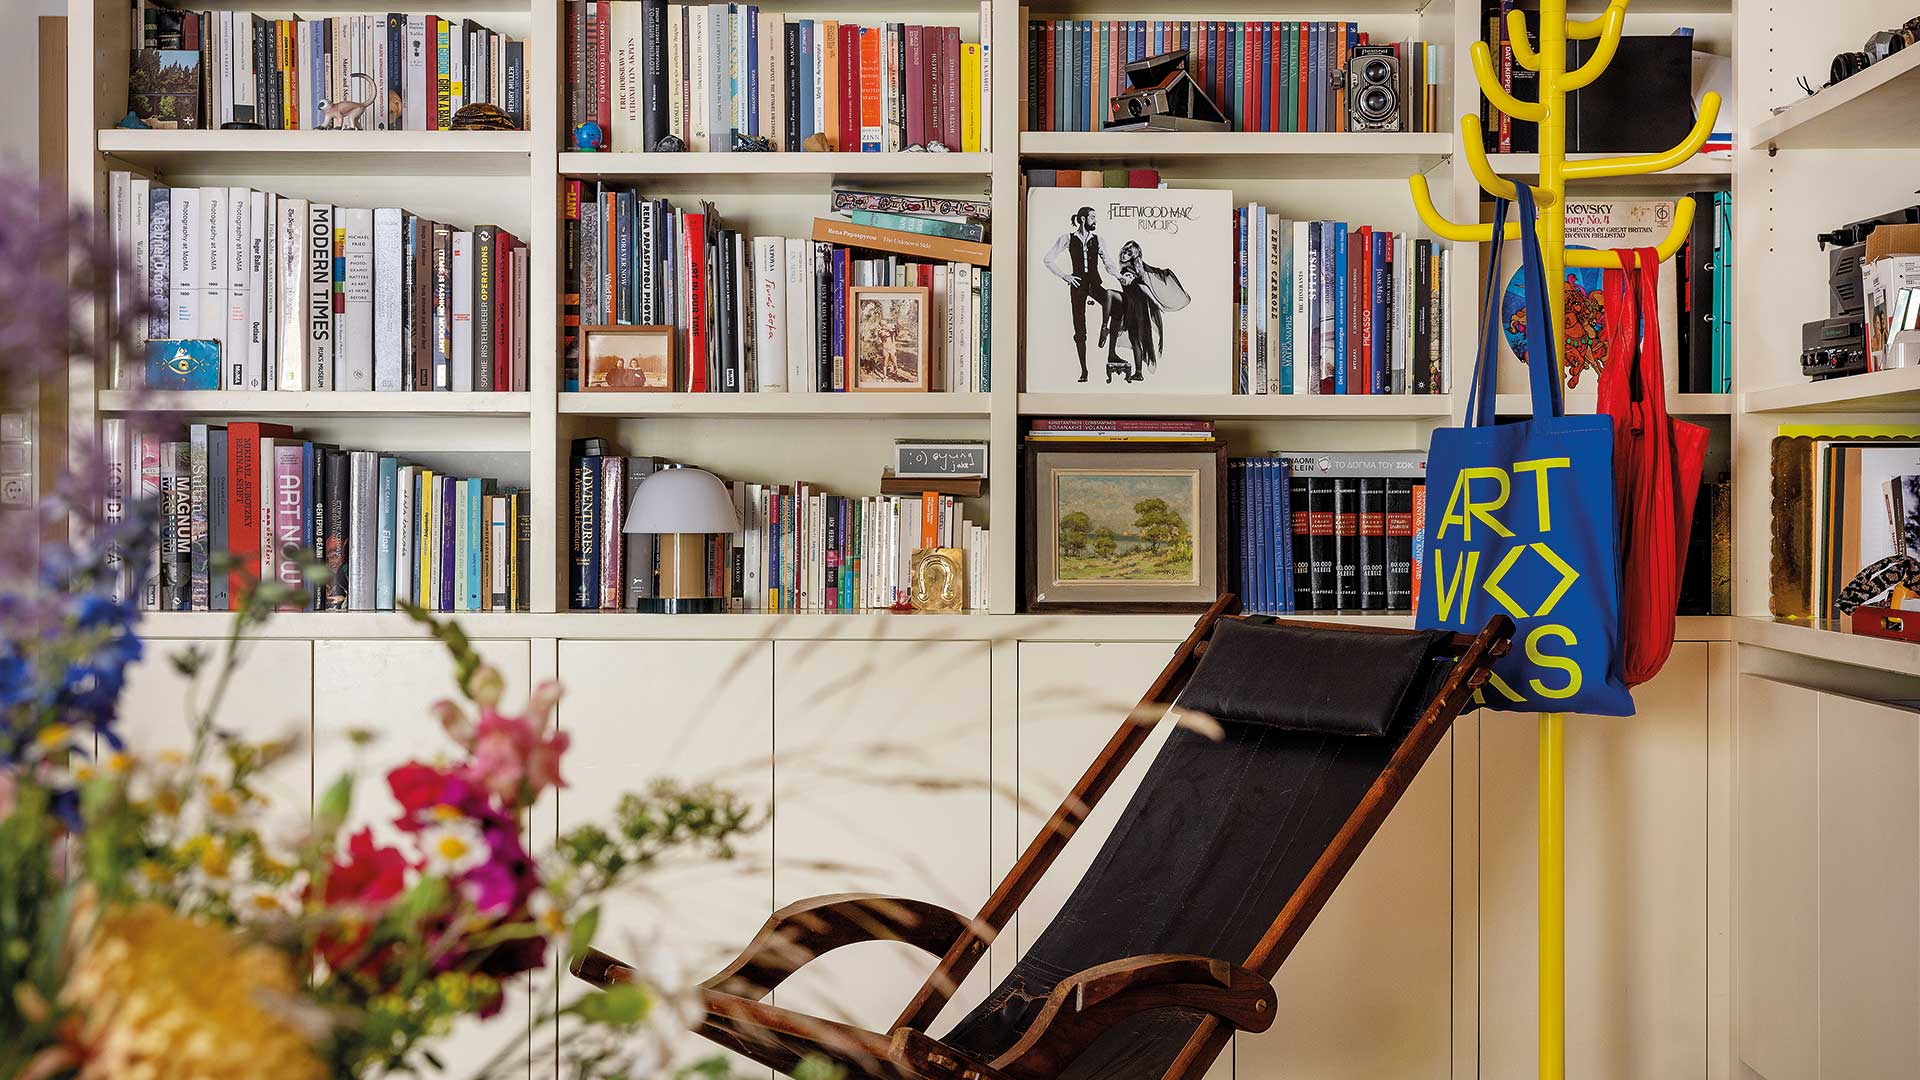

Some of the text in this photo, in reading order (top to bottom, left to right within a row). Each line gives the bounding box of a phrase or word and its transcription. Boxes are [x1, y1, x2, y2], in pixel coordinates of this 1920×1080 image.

[439, 32, 448, 44] KIM
[439, 47, 448, 74] GORDON
[439, 79, 448, 93] GIRL
[181, 201, 189, 241] Photography
[209, 200, 217, 241] Photography
[235, 201, 243, 242] Photography
[828, 227, 842, 235] Rena
[1107, 203, 1198, 221] FLEETWOOD MAC
[1138, 219, 1178, 235] RUMOURS
[1586, 215, 1610, 225] No. 4
[153, 217, 166, 301] Gabriel Orozco
[312, 209, 329, 340] MODERN TIMES
[1309, 249, 1317, 301] TSOCLIS
[253, 238, 261, 343] Roger Ballen Outland
[691, 262, 699, 336] ART IN OUR TIME
[235, 438, 243, 504] RETINAL SHIFT
[575, 469, 582, 477] in
[1335, 461, 1414, 469] ΤΟ ΔΟΓΜΑ ΤΟΥ ΣΟΚ
[192, 464, 205, 513] Sultan
[1437, 457, 1570, 542] ART
[177, 477, 190, 552] MAGNUM
[279, 474, 300, 583] ART NOW
[582, 467, 592, 554] ADVENTURES
[382, 530, 390, 553] Float
[574, 516, 582, 551] Literature
